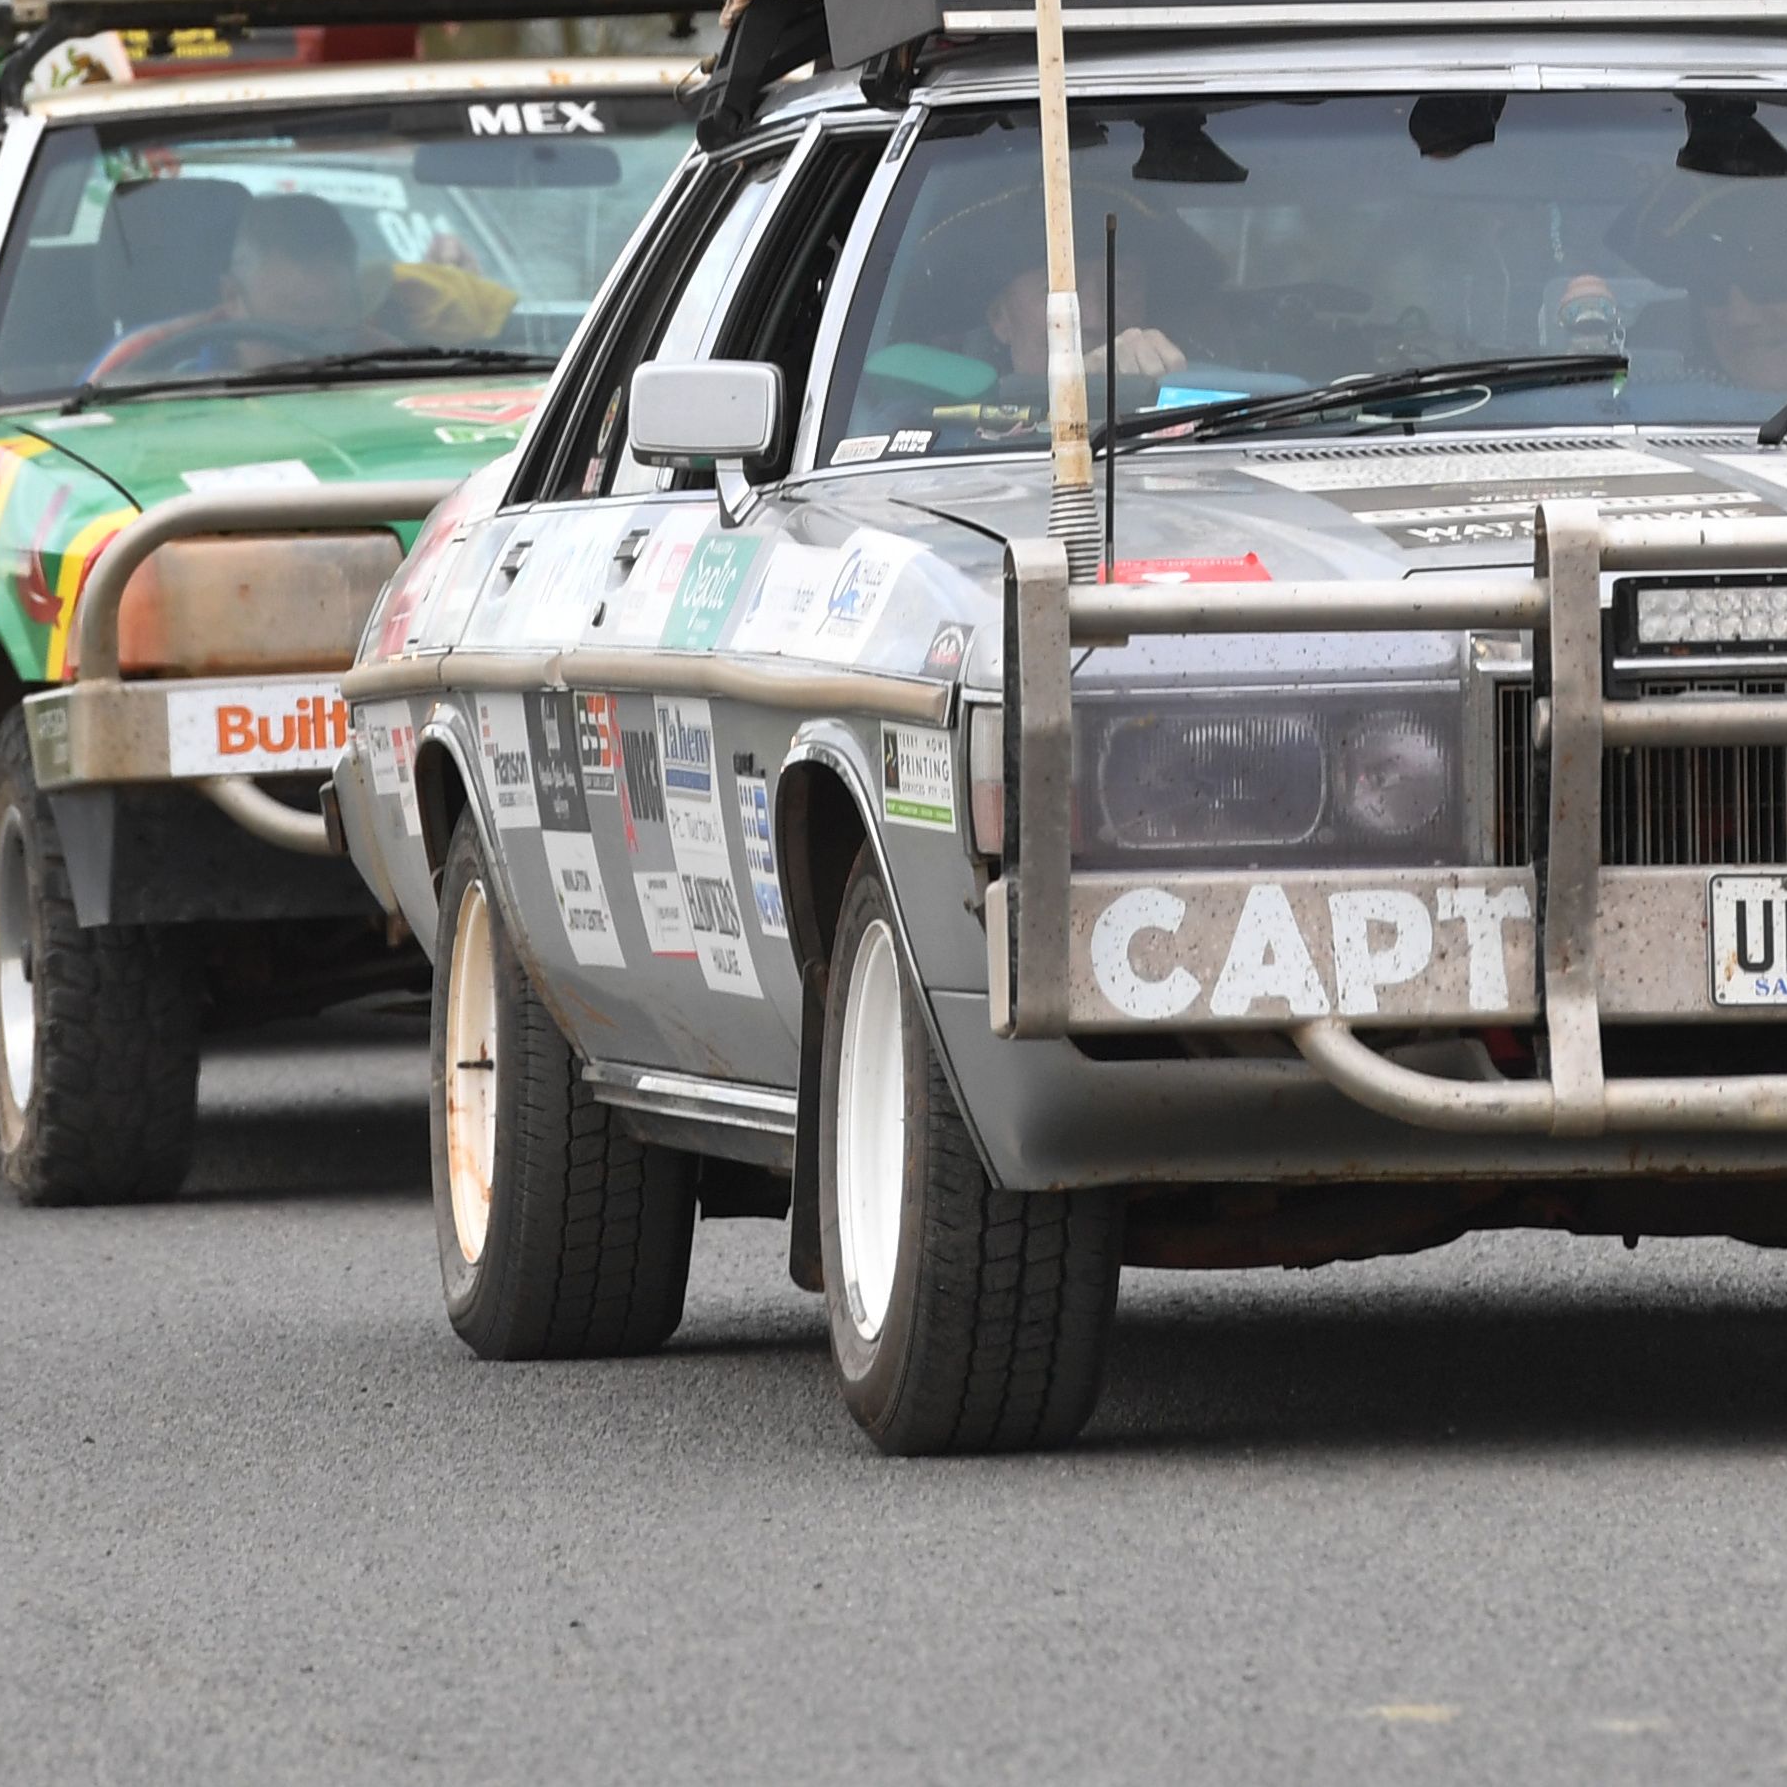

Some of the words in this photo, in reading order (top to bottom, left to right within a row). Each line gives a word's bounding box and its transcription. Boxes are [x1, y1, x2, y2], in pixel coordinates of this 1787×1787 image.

[468, 101, 605, 135] MEX
[216, 696, 348, 755] Built
[494, 742, 530, 787] Hanson
[900, 752, 950, 783] PRINTING
[1090, 884, 1533, 1019] CAPT
